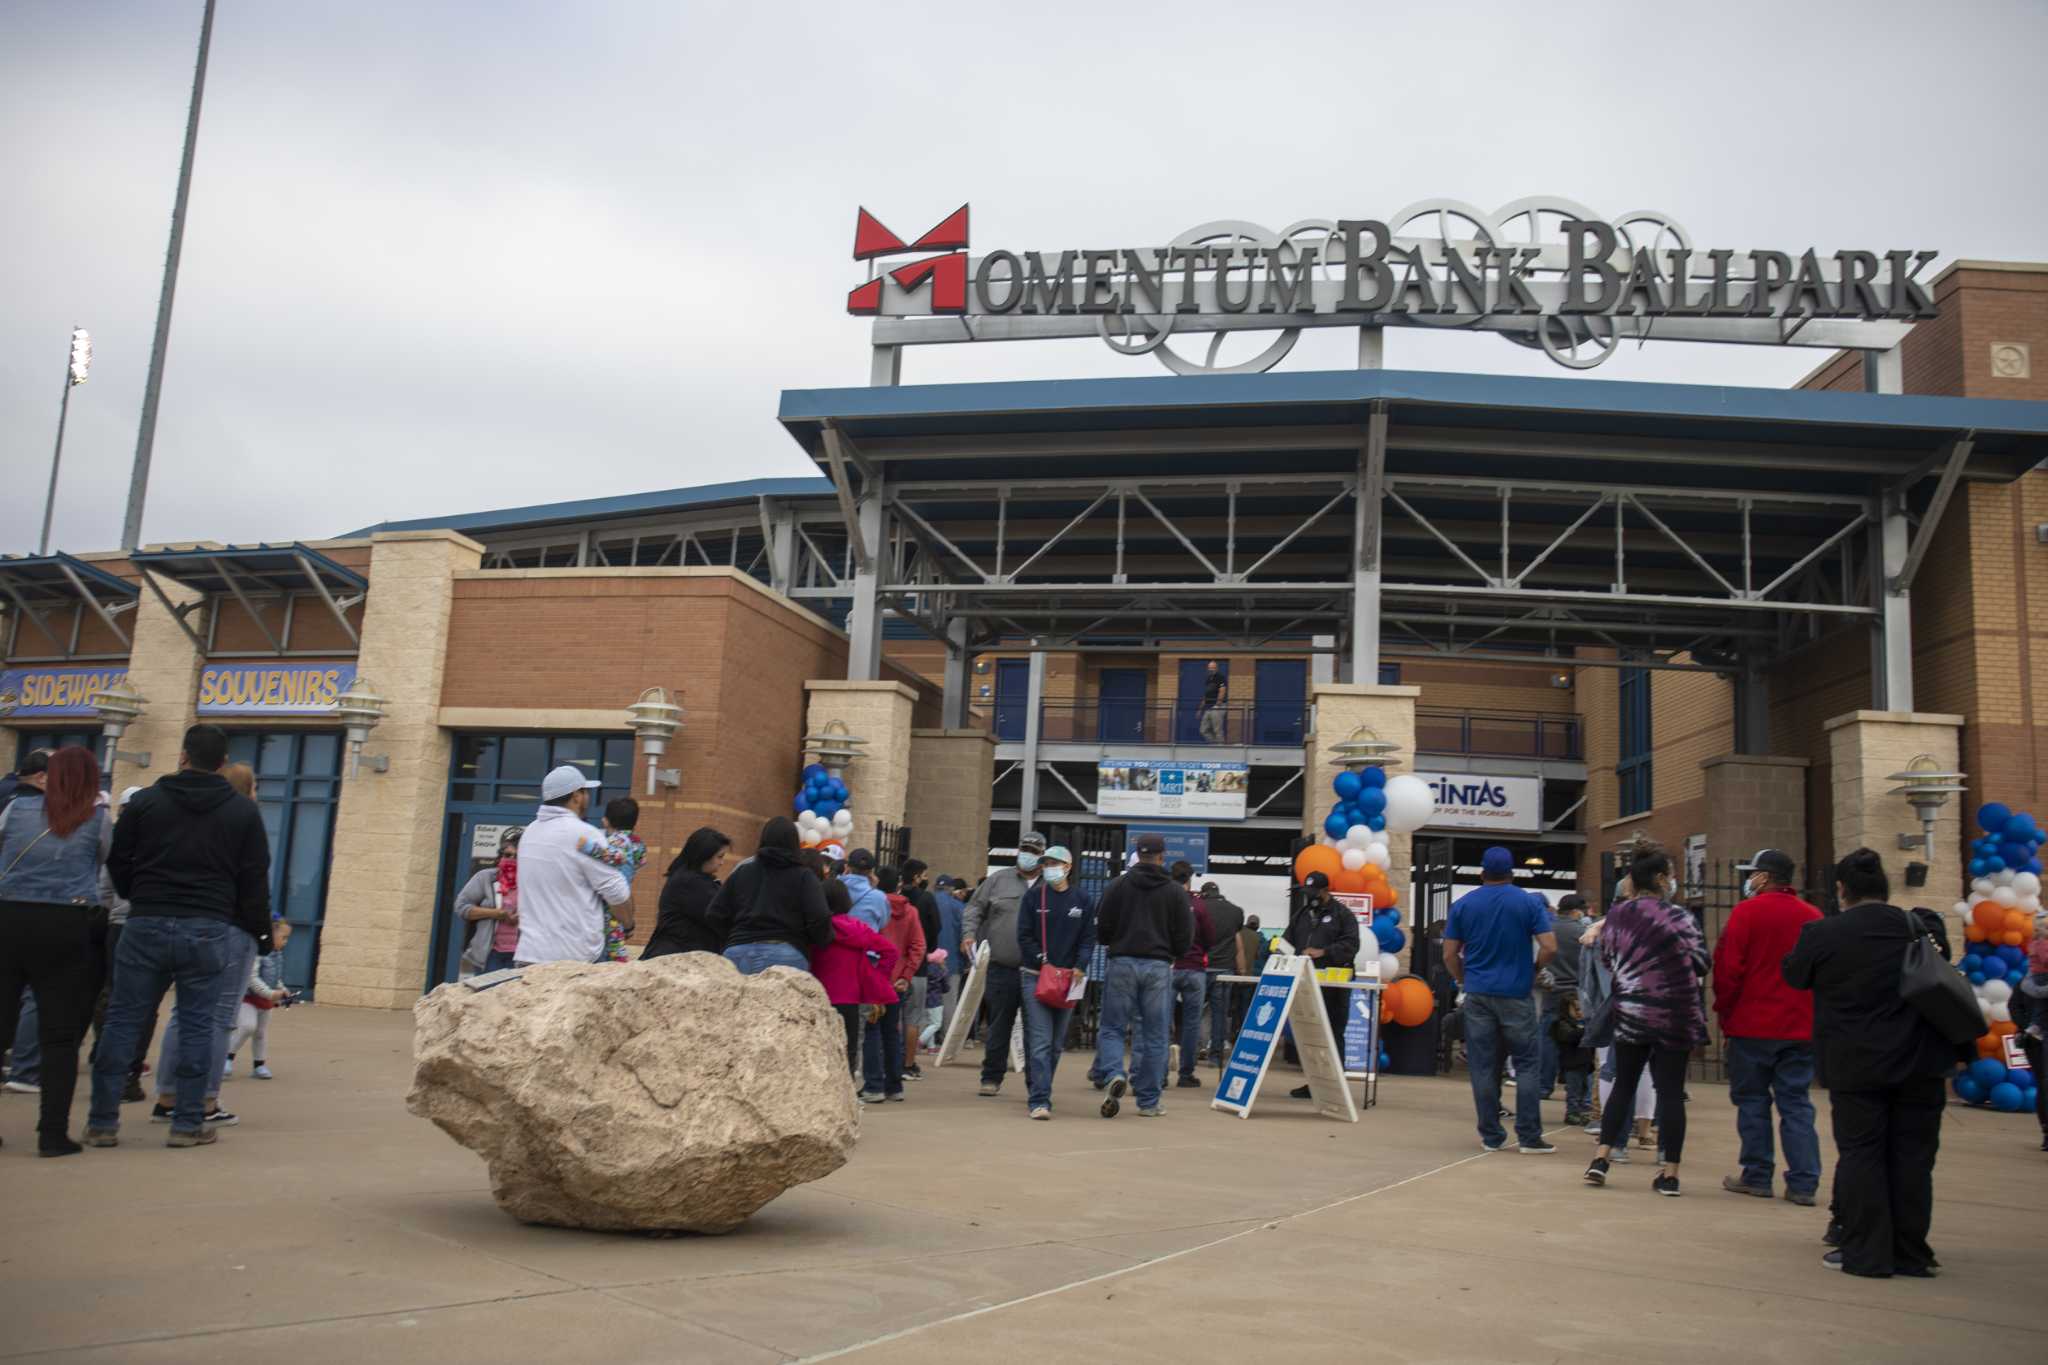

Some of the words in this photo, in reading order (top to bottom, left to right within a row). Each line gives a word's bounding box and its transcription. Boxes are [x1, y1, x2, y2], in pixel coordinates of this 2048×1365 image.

[846, 202, 1317, 316] MOMENTUM
[1336, 218, 1543, 314] BANK
[1560, 219, 1939, 320] BALLPARK
[200, 670, 340, 705] SOUVENIRS
